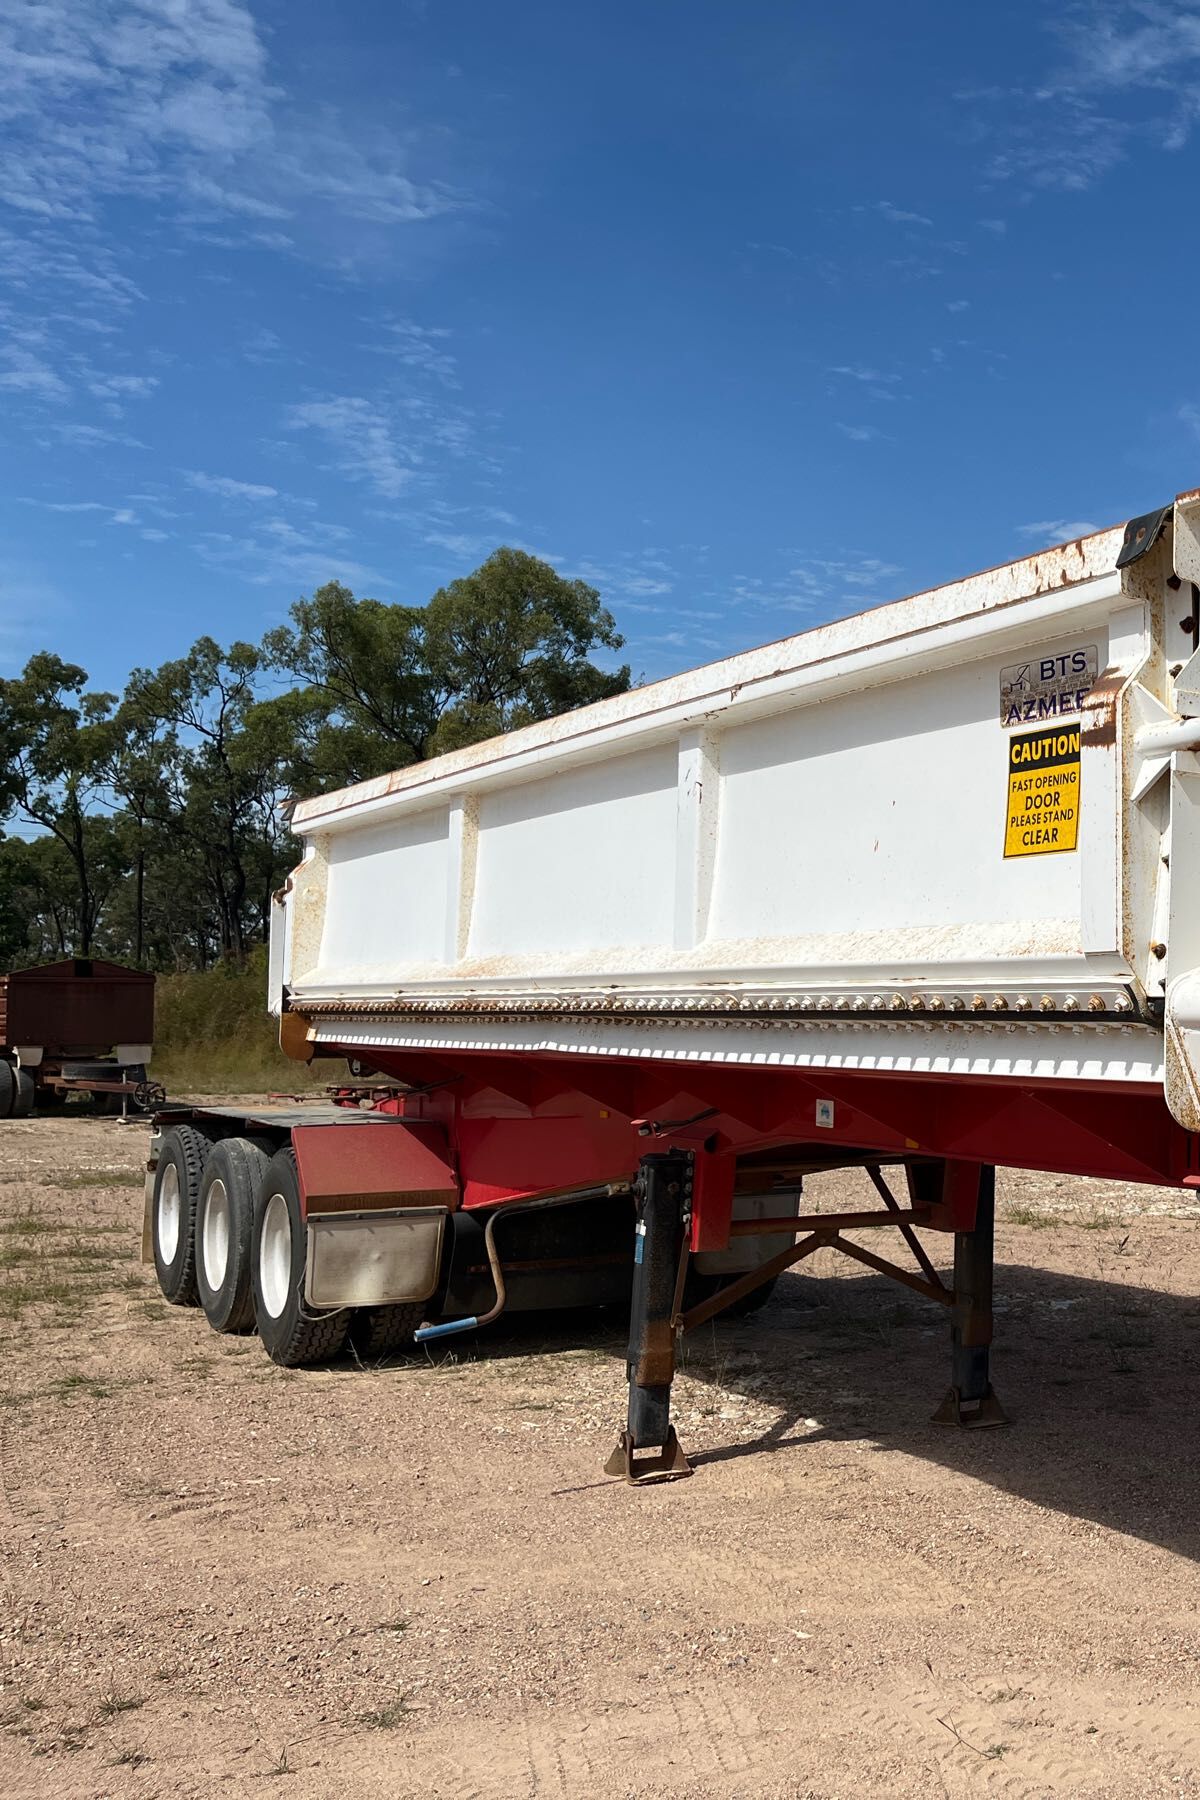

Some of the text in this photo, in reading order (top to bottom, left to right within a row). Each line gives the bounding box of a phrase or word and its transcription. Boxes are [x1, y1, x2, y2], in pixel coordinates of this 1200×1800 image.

[1040, 651, 1086, 681] BTS
[1011, 732, 1080, 764] CAUTION
[1012, 771, 1076, 793] FAST OPENING
[1025, 791, 1060, 811] DOOR
[1011, 808, 1074, 828] PLEASE STAND
[1022, 827, 1059, 846] CLEAR
